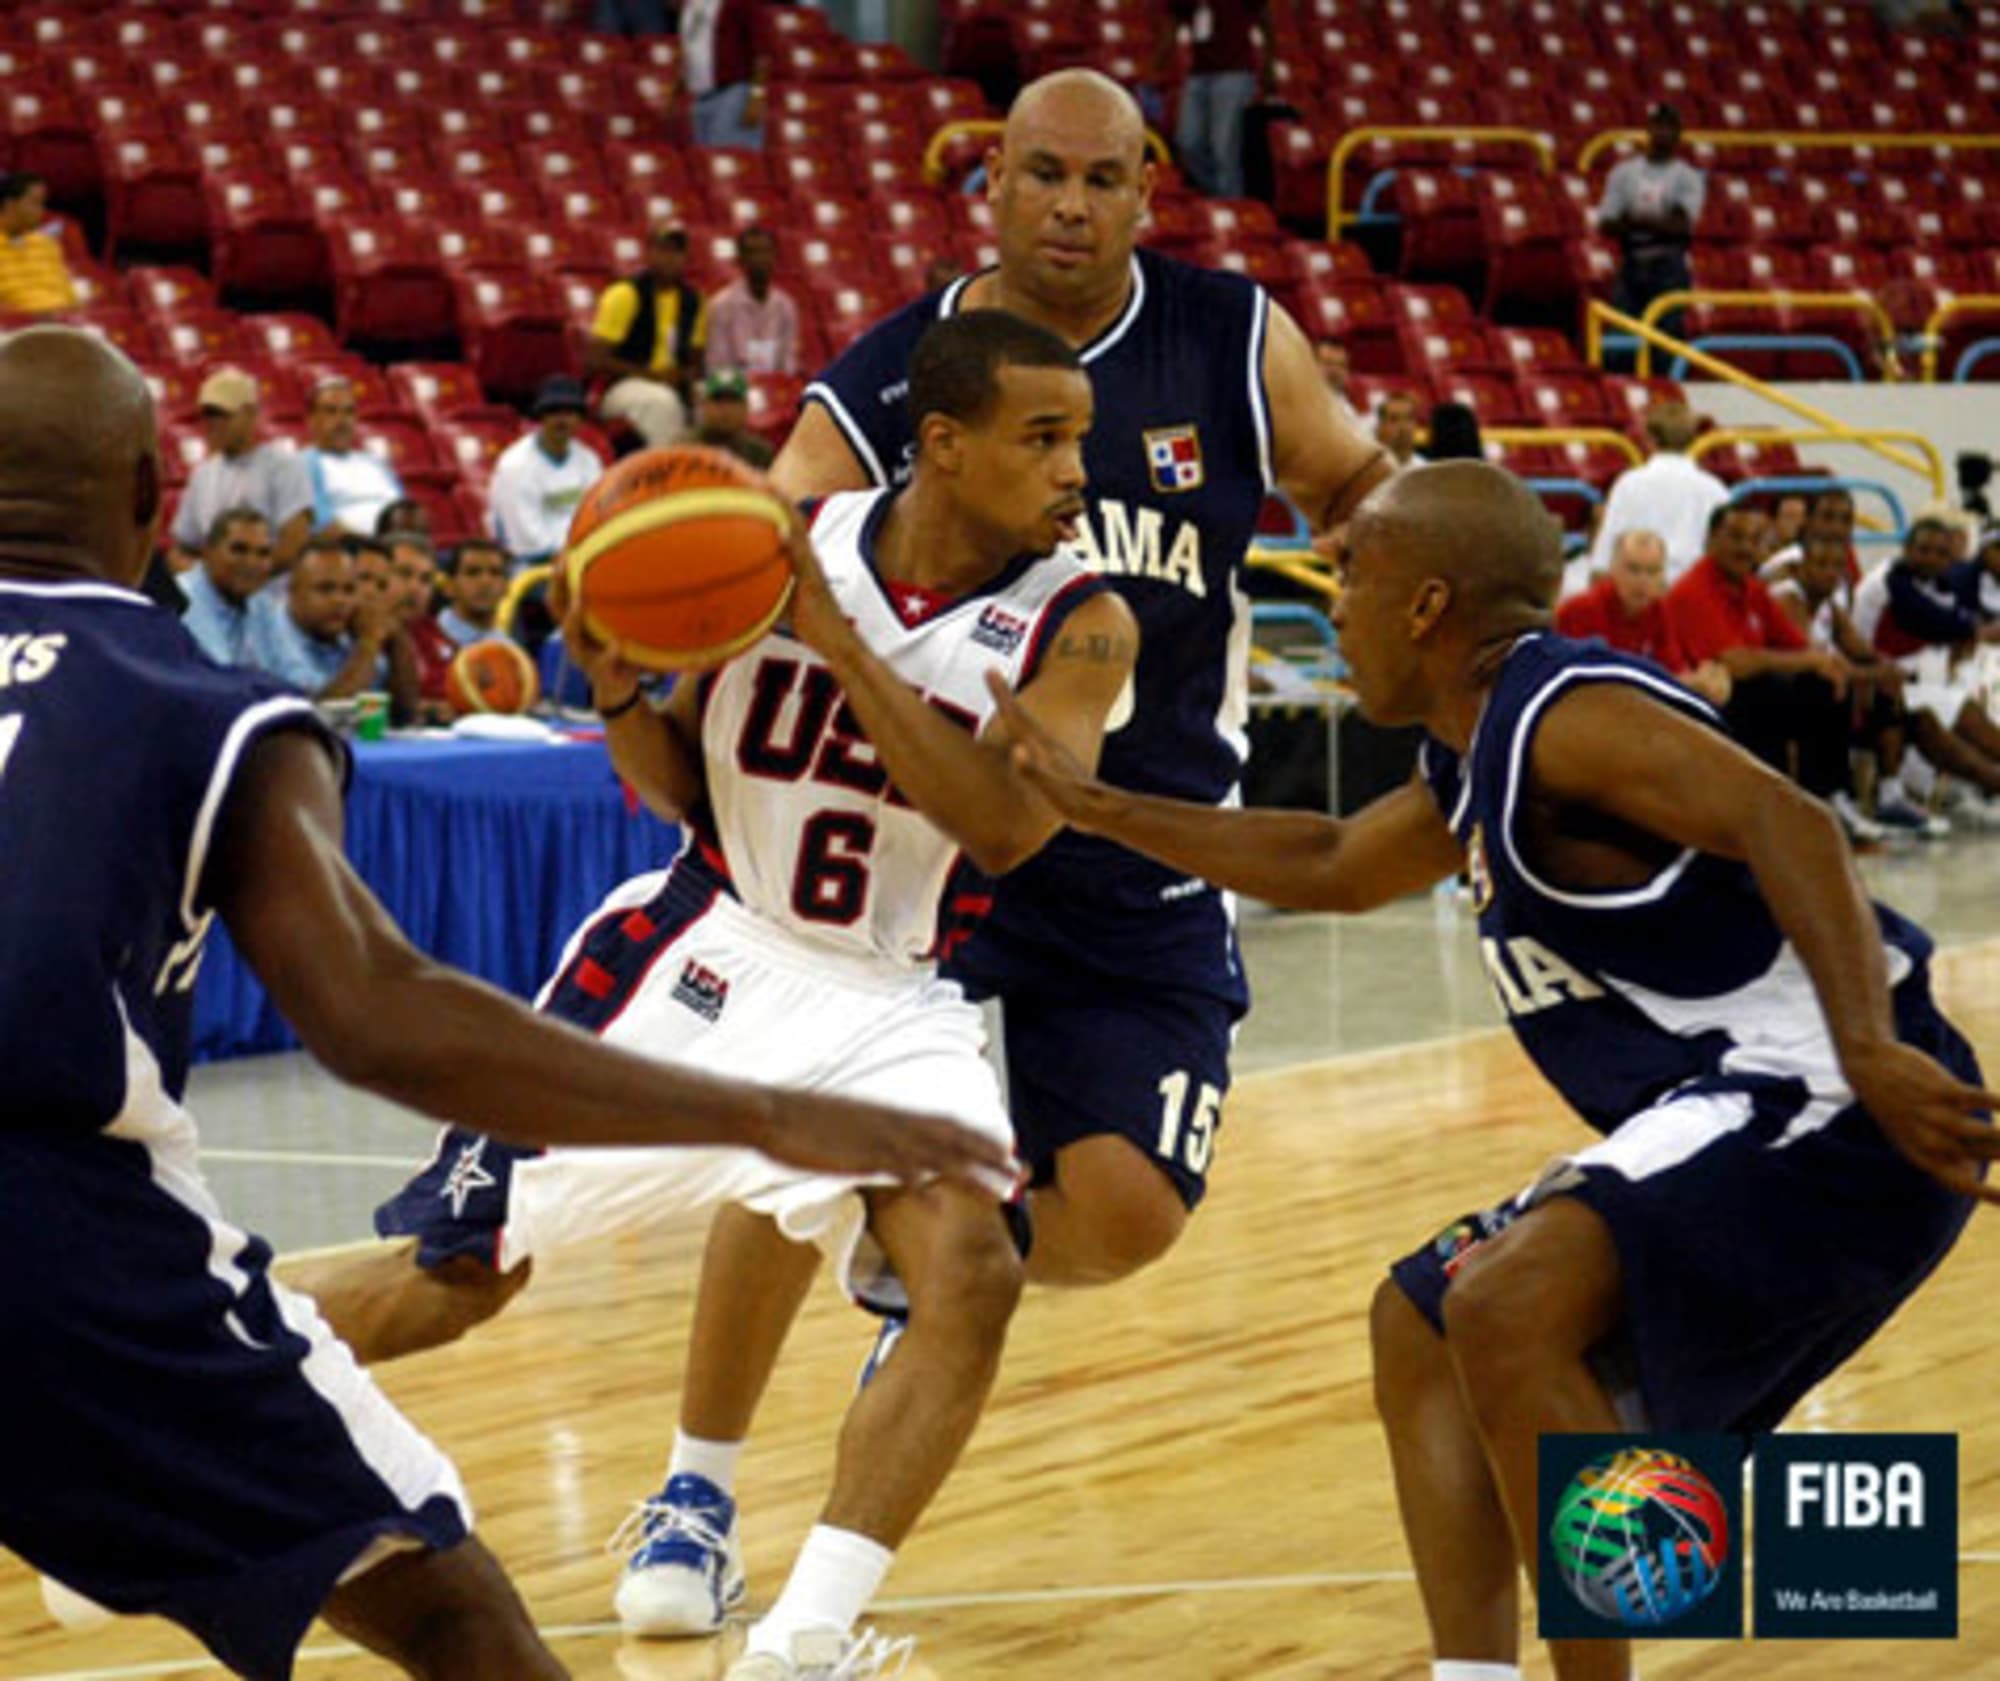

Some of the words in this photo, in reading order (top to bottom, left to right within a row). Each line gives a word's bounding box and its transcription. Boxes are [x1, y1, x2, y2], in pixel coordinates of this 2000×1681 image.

[736, 656, 981, 807] US
[792, 807, 876, 927] 6
[679, 957, 728, 1008] USA
[1158, 1068, 1220, 1174] 15
